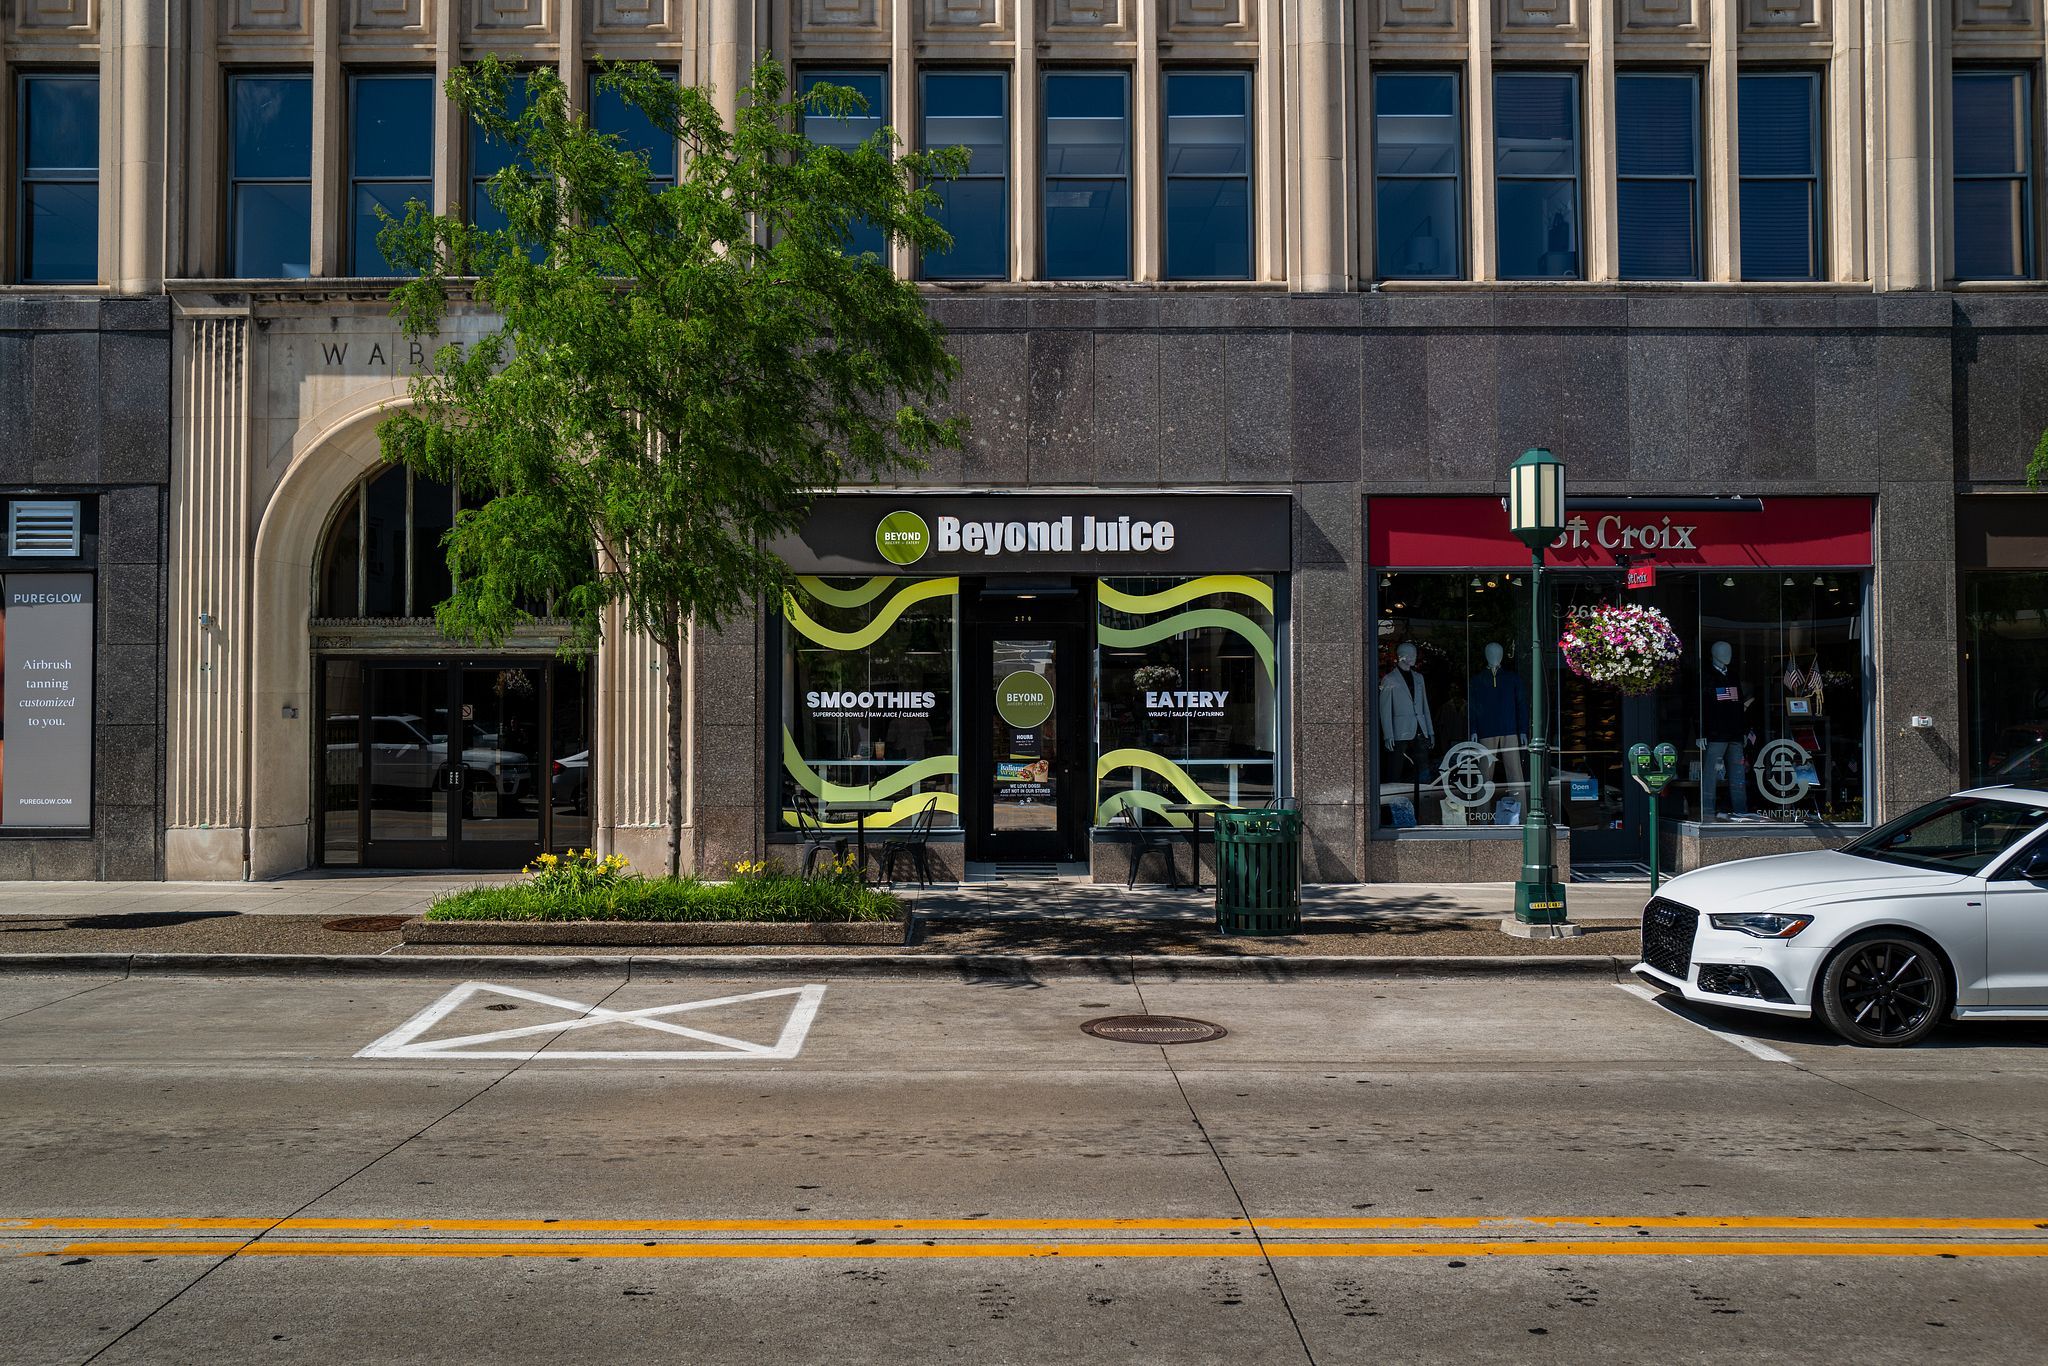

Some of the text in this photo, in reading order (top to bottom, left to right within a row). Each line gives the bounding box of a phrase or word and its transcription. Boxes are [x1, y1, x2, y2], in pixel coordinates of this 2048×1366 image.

[884, 532, 921, 541] BEYOND
[938, 516, 1175, 556] Beyond Juice
[1597, 515, 1698, 549] Croix
[14, 593, 82, 604] PUREGLOW
[23, 660, 72, 670] Airbrush
[26, 679, 69, 691] tanning
[19, 697, 76, 708] customized
[806, 691, 936, 709] SMOOTHIES
[1006, 693, 1044, 702] BEYOND
[1146, 691, 1229, 708] EATERY
[28, 718, 66, 729] to you.
[1571, 783, 1590, 791] Open
[1470, 812, 1496, 821] CROIX
[1756, 809, 1810, 818] SAINT CROIX
